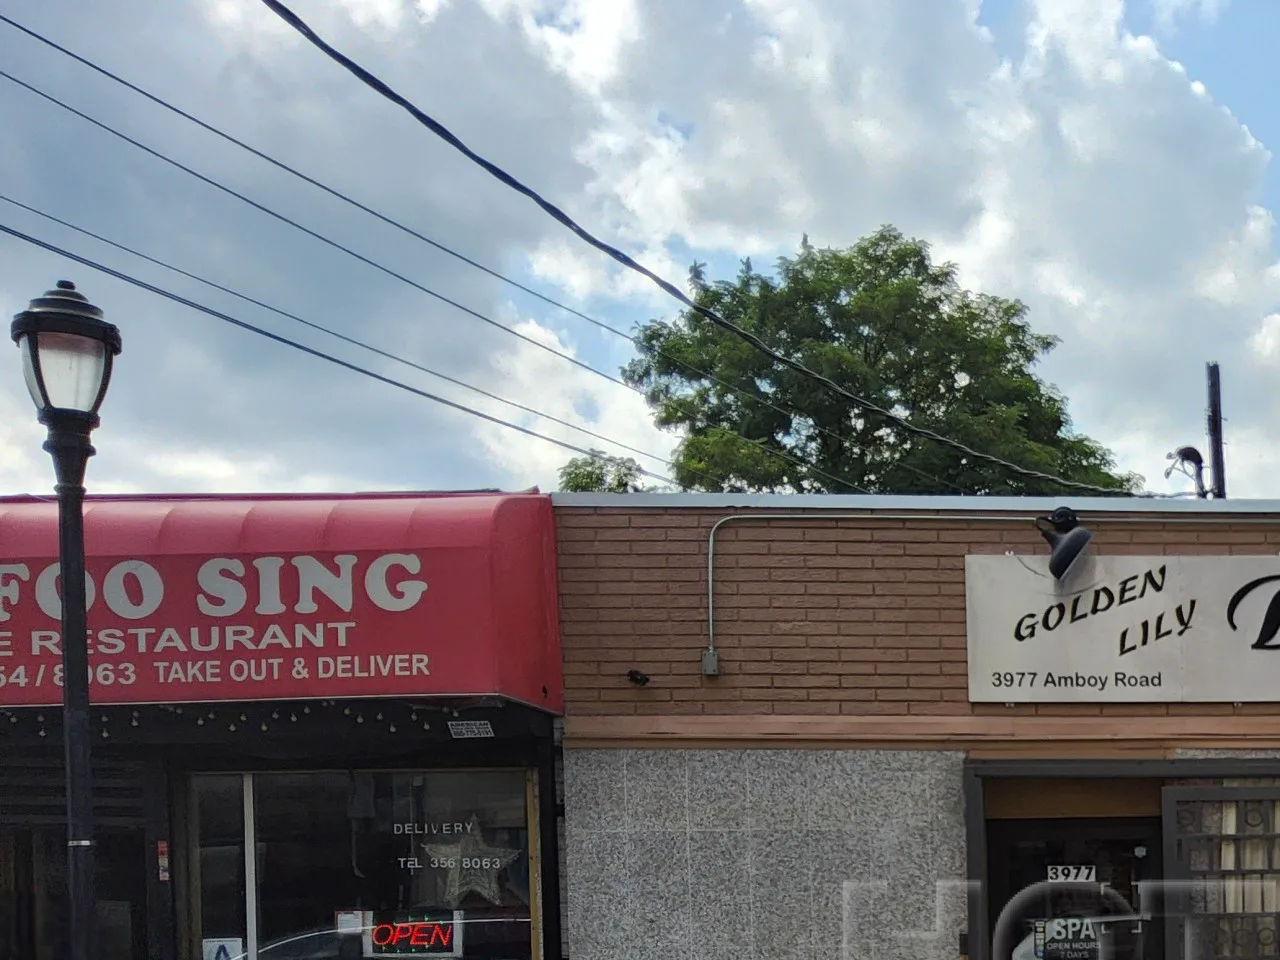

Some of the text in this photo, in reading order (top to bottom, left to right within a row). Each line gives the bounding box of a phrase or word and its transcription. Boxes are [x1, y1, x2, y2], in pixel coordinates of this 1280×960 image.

[197, 553, 428, 617] SING
[1014, 564, 1166, 642] GOLDEN
[1118, 599, 1197, 656] LILY
[31, 622, 356, 656] RSTAURANT
[153, 660, 221, 683] TAKE
[229, 658, 283, 682] OUT
[291, 657, 309, 680] &
[318, 654, 430, 679] DELIVER
[991, 672, 1162, 691] 3977 Amboy Road
[394, 822, 473, 834] DELIVERY
[398, 857, 501, 869] TEL 356 8063
[1049, 867, 1093, 880] 3977
[372, 923, 452, 945] OPEN
[1052, 919, 1096, 939] SPA
